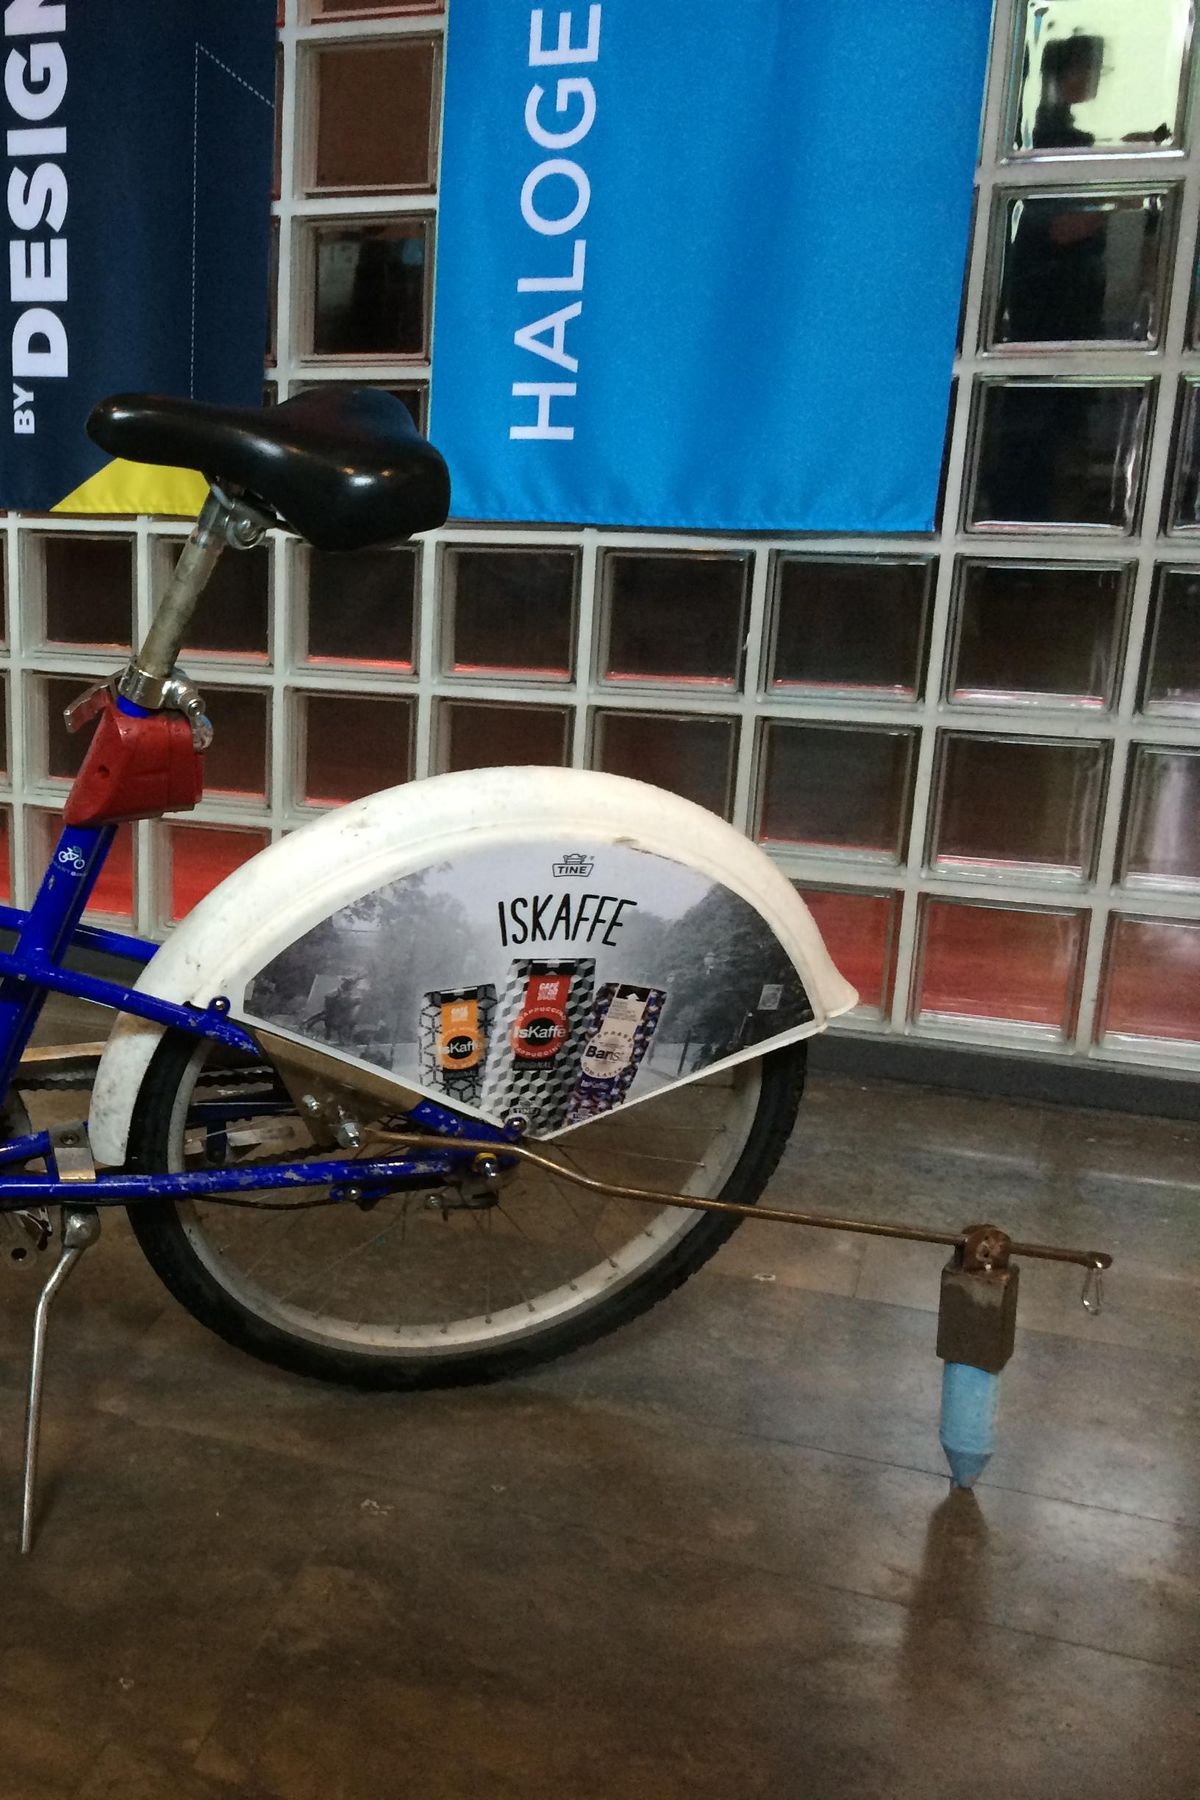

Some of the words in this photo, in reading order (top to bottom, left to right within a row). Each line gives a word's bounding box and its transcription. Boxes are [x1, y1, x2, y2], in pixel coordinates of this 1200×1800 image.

[509, 4, 602, 441] HALOGE
[13, 384, 35, 434] BY
[557, 866, 588, 874] TINE
[498, 893, 638, 947] ISKAFFE
[514, 1025, 567, 1039] IsKaffe
